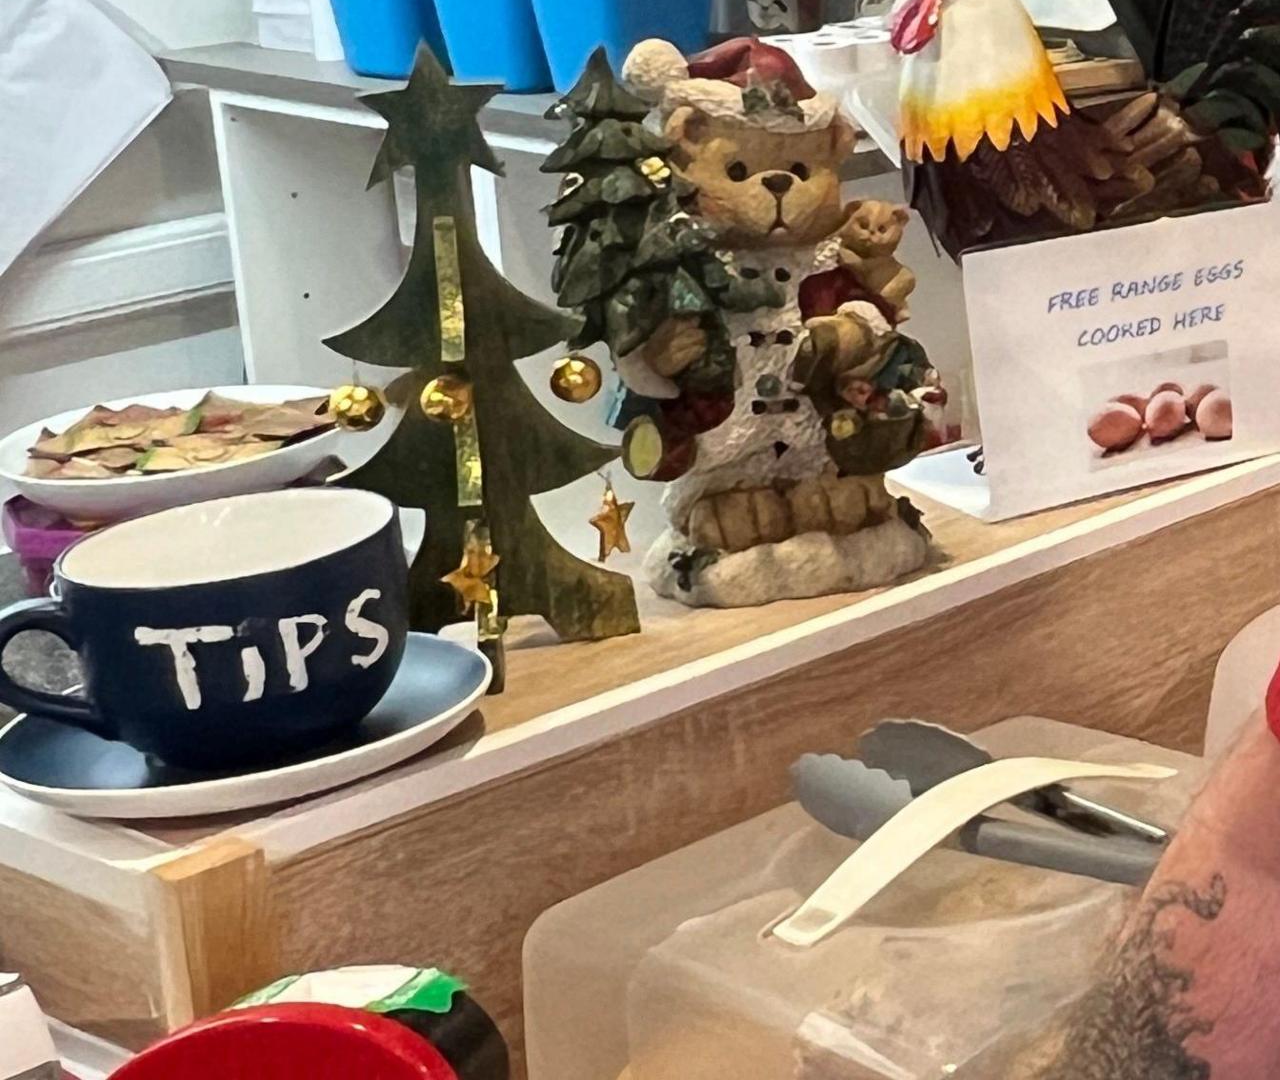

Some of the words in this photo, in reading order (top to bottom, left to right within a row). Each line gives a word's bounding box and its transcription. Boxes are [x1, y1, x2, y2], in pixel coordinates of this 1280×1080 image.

[1047, 287, 1099, 313] FREE
[1110, 272, 1184, 302] RANGE
[1193, 259, 1244, 286] EGGS
[1077, 317, 1161, 347] COOKED
[1172, 304, 1225, 331] HERE
